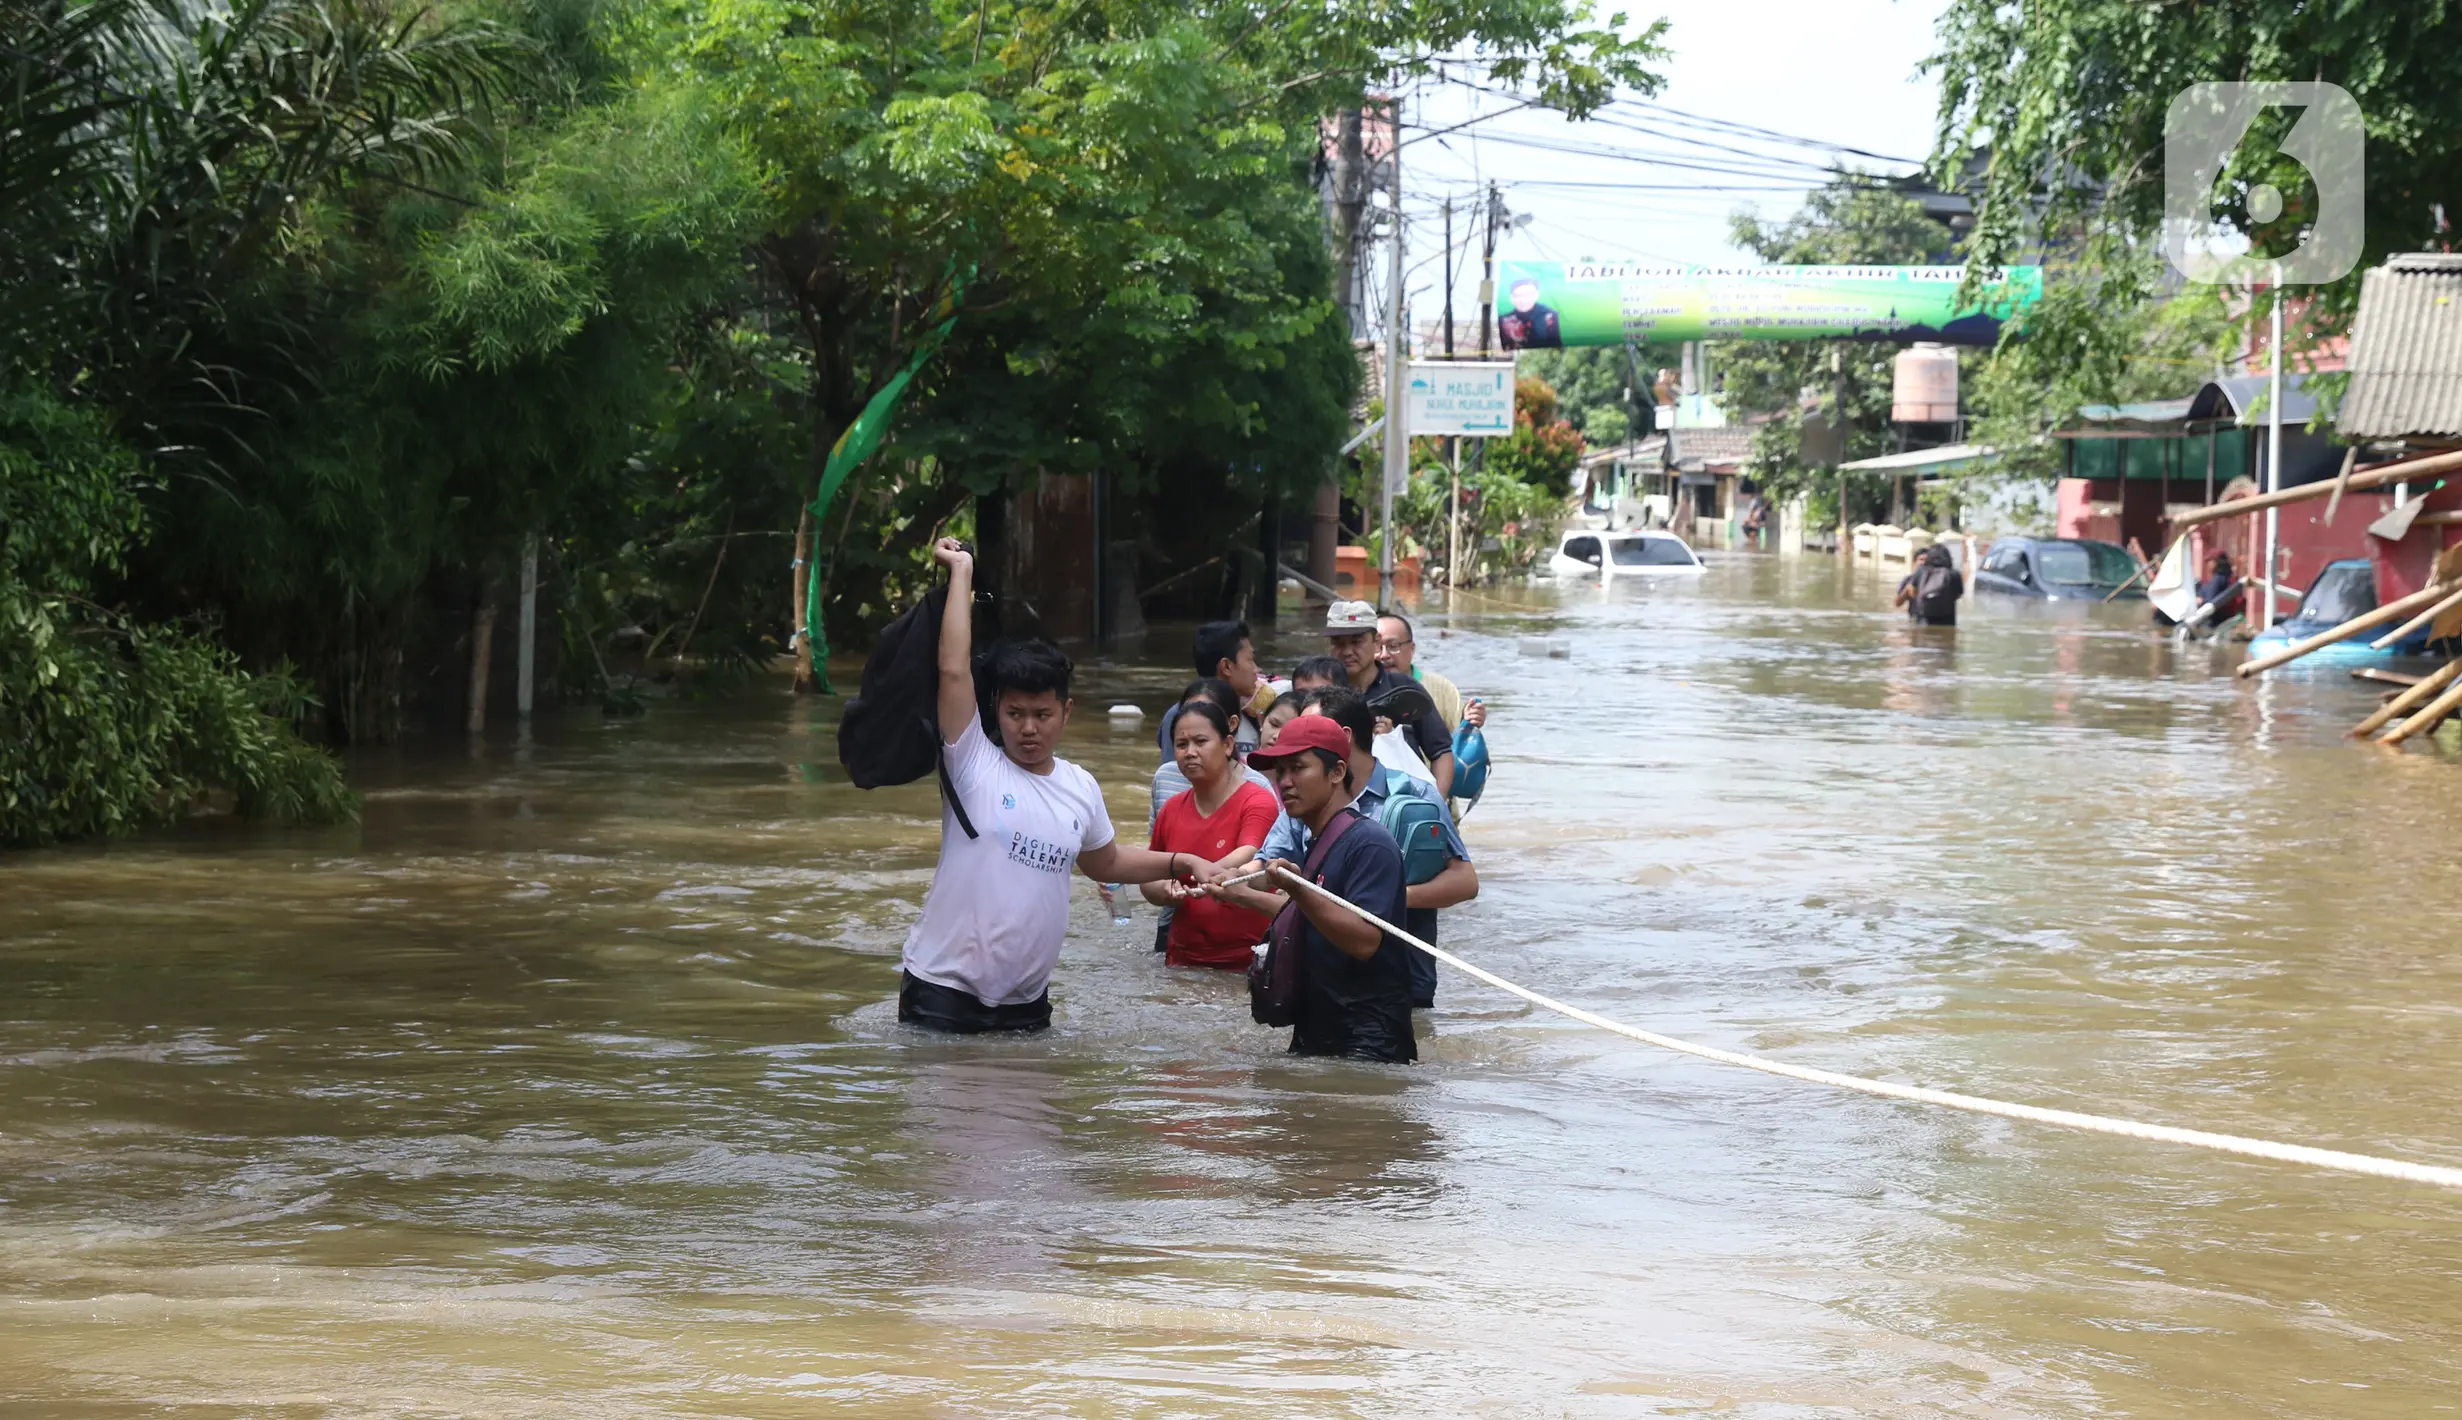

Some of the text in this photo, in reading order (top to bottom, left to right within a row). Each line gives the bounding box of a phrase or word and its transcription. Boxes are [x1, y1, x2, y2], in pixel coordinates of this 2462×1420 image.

[1446, 382, 1493, 396] MASJID
[1011, 841, 1067, 867] TALENT
[1013, 831, 1070, 857] DIGITAL
[1008, 852, 1063, 874] SCHOLARSHIP
